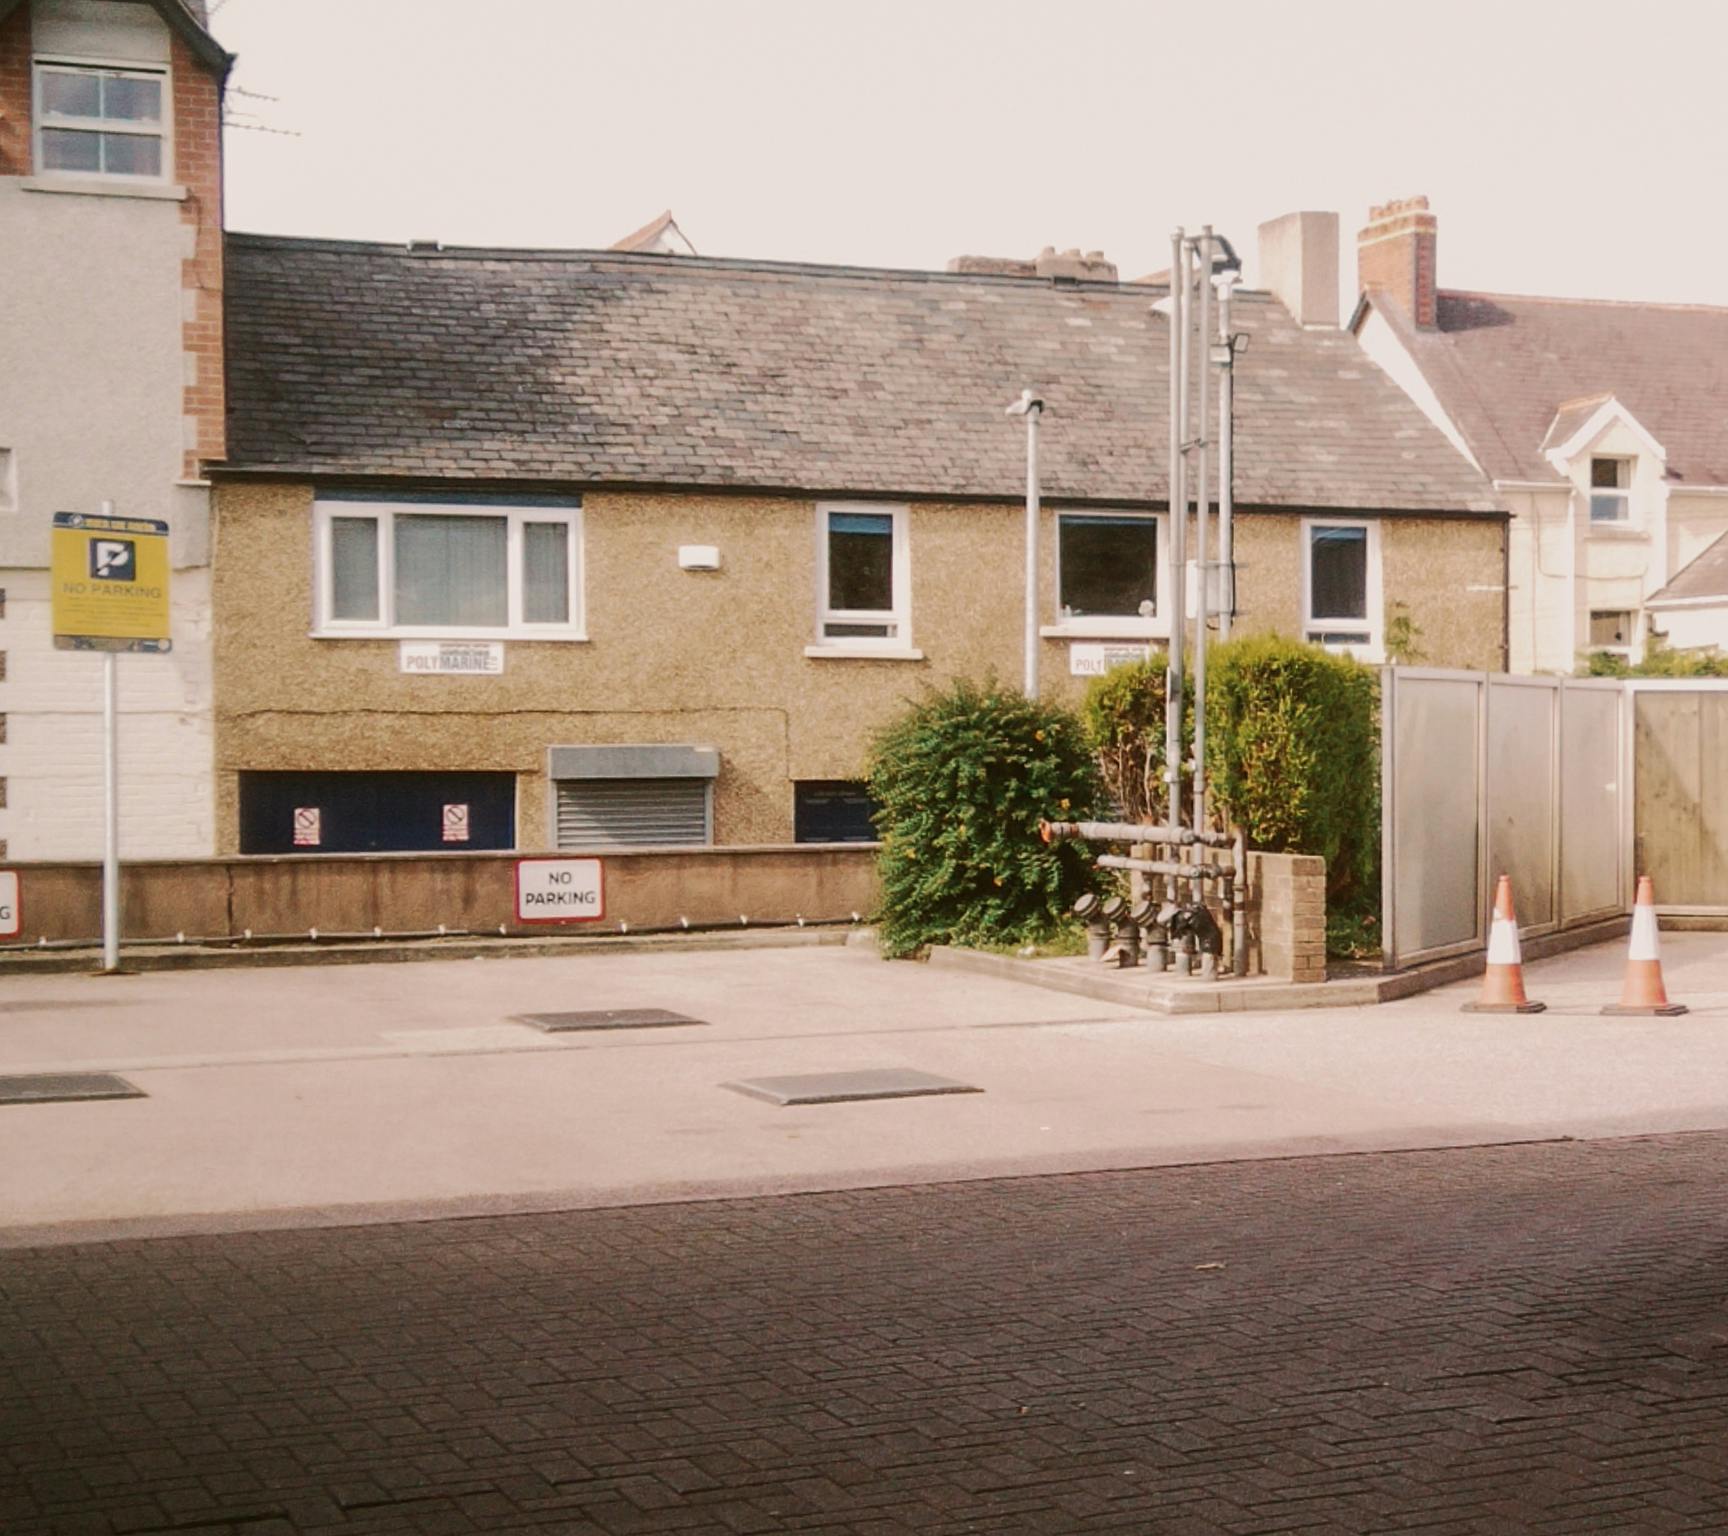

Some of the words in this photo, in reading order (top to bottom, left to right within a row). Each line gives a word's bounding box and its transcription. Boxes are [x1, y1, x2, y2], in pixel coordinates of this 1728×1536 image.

[63, 582, 87, 594] NO
[91, 583, 162, 598] PARKING
[548, 871, 573, 884] NO
[525, 890, 597, 905] PARKING
